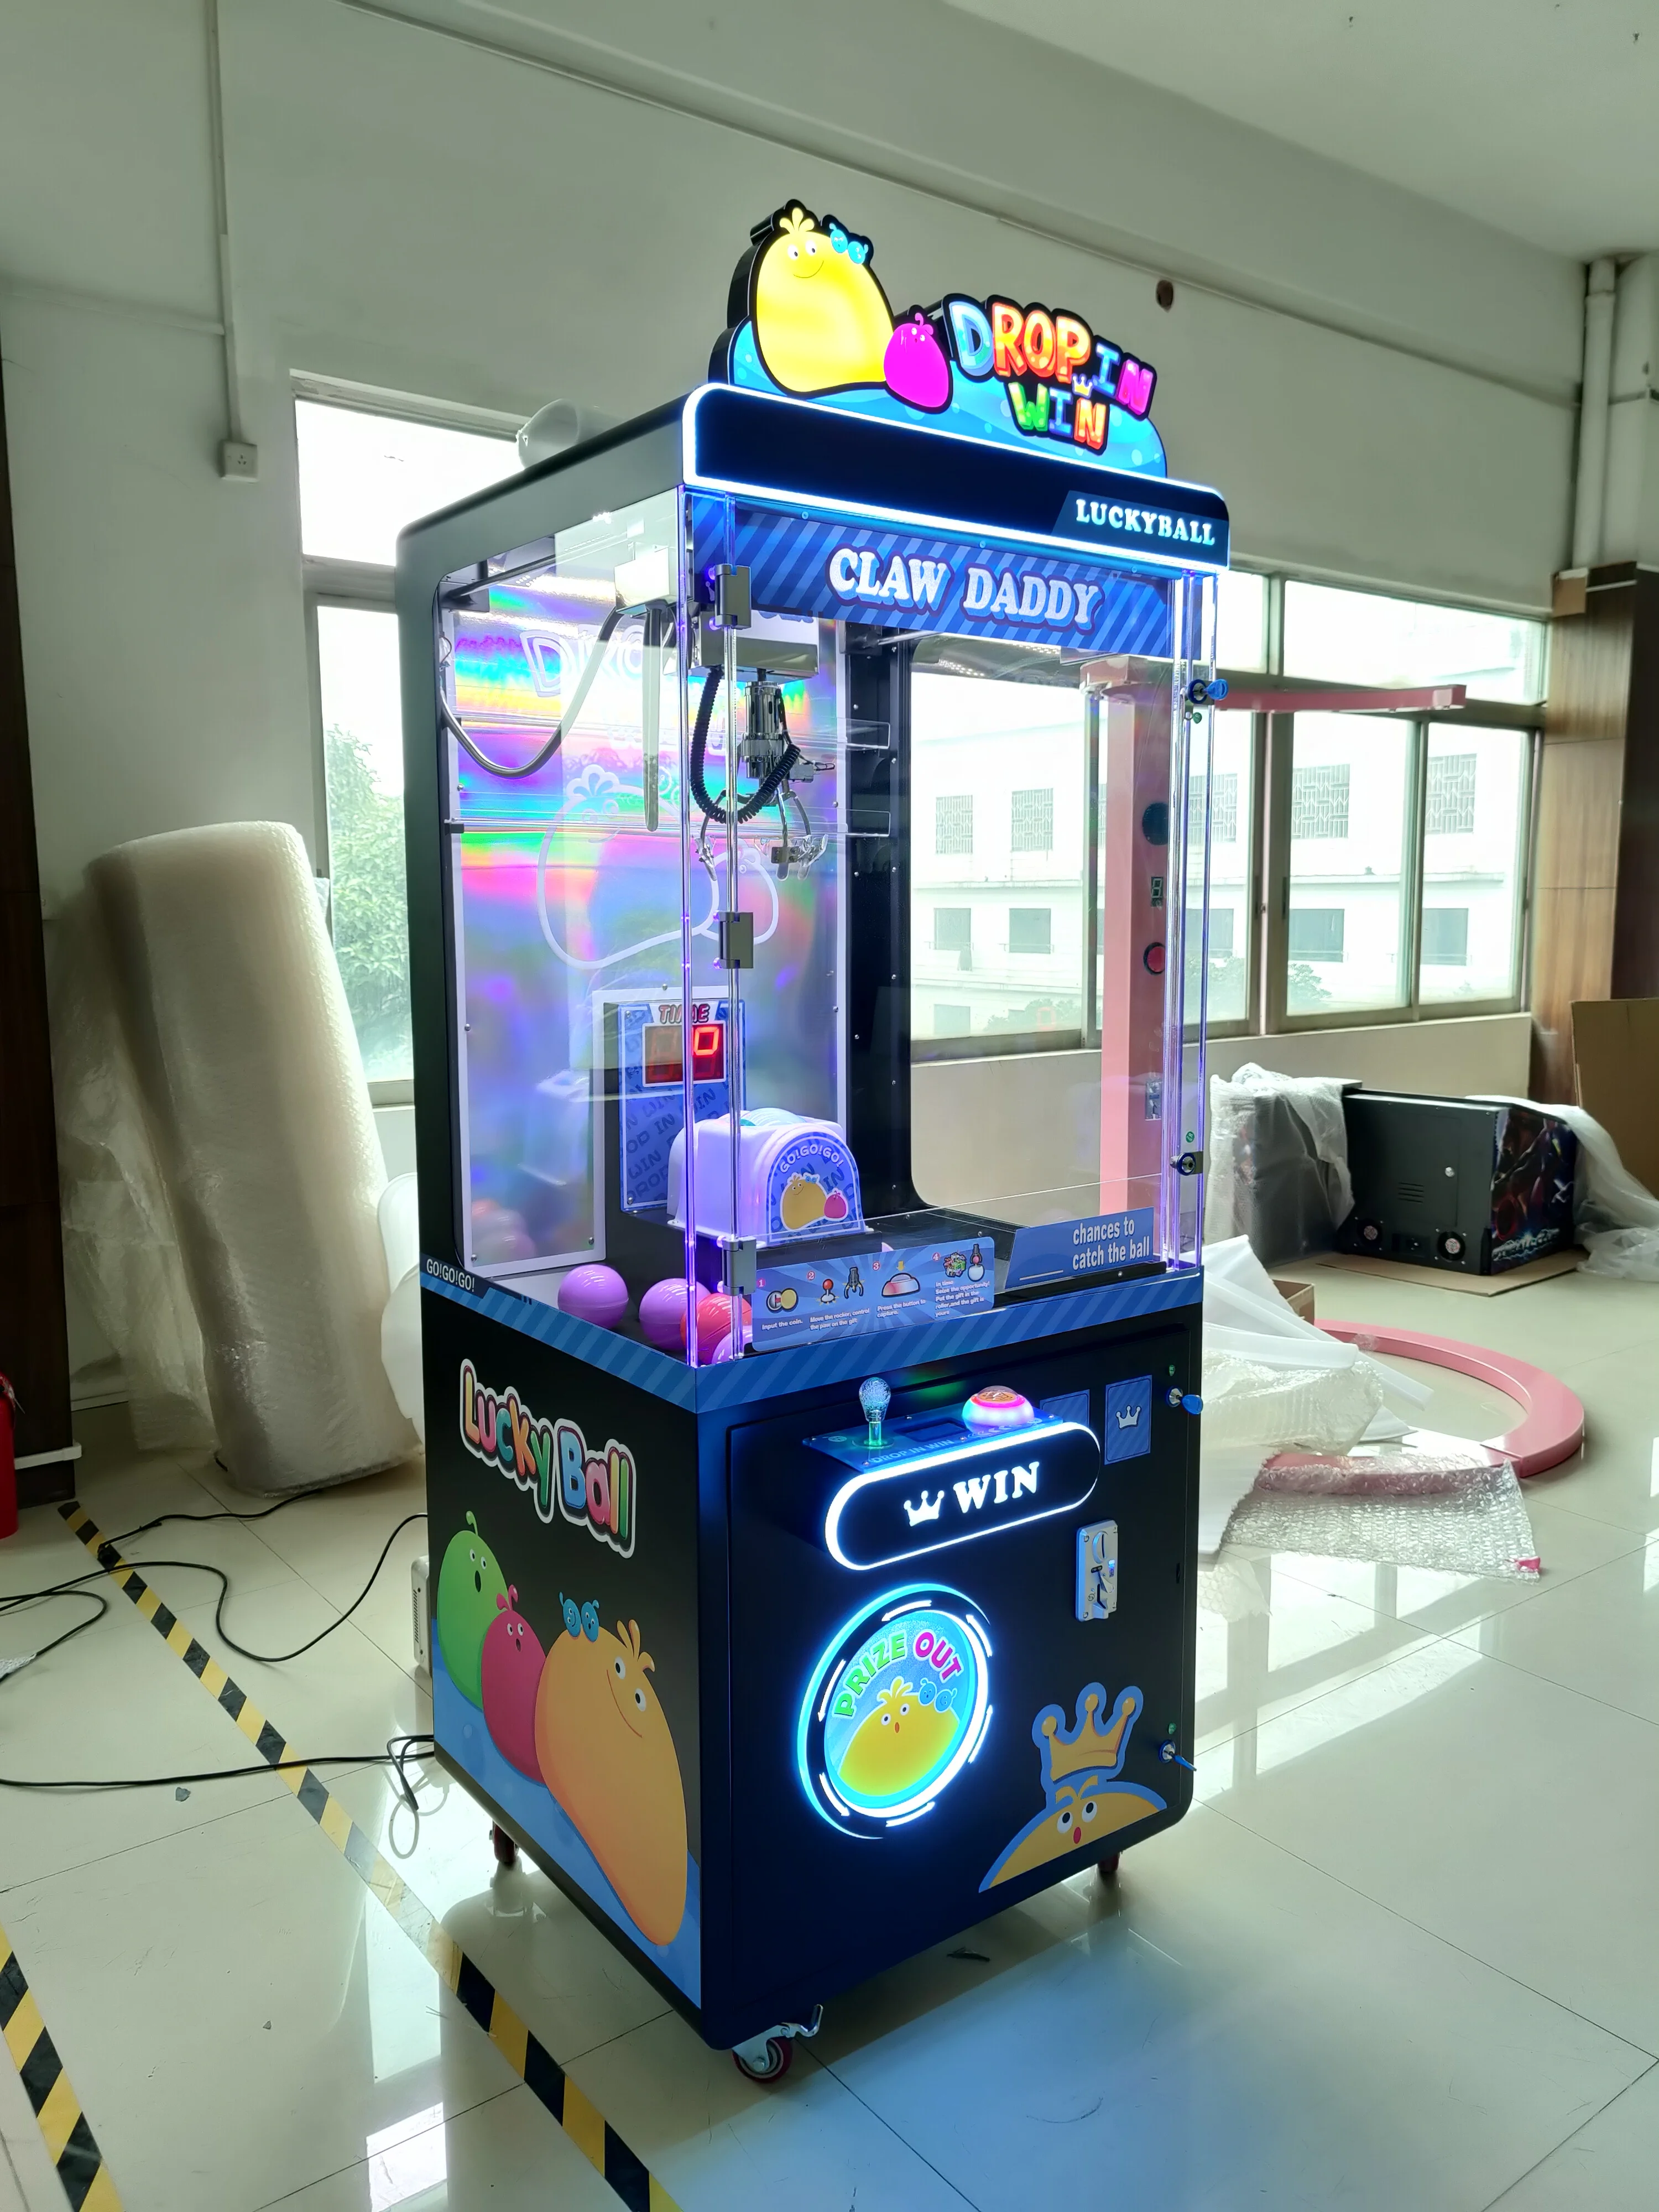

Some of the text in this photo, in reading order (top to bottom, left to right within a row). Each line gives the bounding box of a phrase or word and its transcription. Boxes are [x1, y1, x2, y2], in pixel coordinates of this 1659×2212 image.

[948, 301, 1154, 415] DROP IN
[1008, 382, 1106, 450] WIN
[1076, 499, 1215, 546] LUCKYBALL
[830, 548, 1103, 629] CLAW DADDY
[780, 1144, 844, 1173] GO!GO!GO!
[1073, 1216, 1135, 1245] chances to
[1072, 1235, 1150, 1270] catch the ball
[426, 1258, 475, 1292] GO!GO!GO!
[960, 1281, 990, 1291] opportunity!
[761, 1322, 778, 1331] Input
[852, 1308, 870, 1316] control
[465, 1367, 632, 1542] Lucky Ball
[870, 1439, 955, 1463] DROP IN WIN
[953, 1461, 1040, 1514] WIN
[833, 1631, 962, 1717] PRIZE OUT
